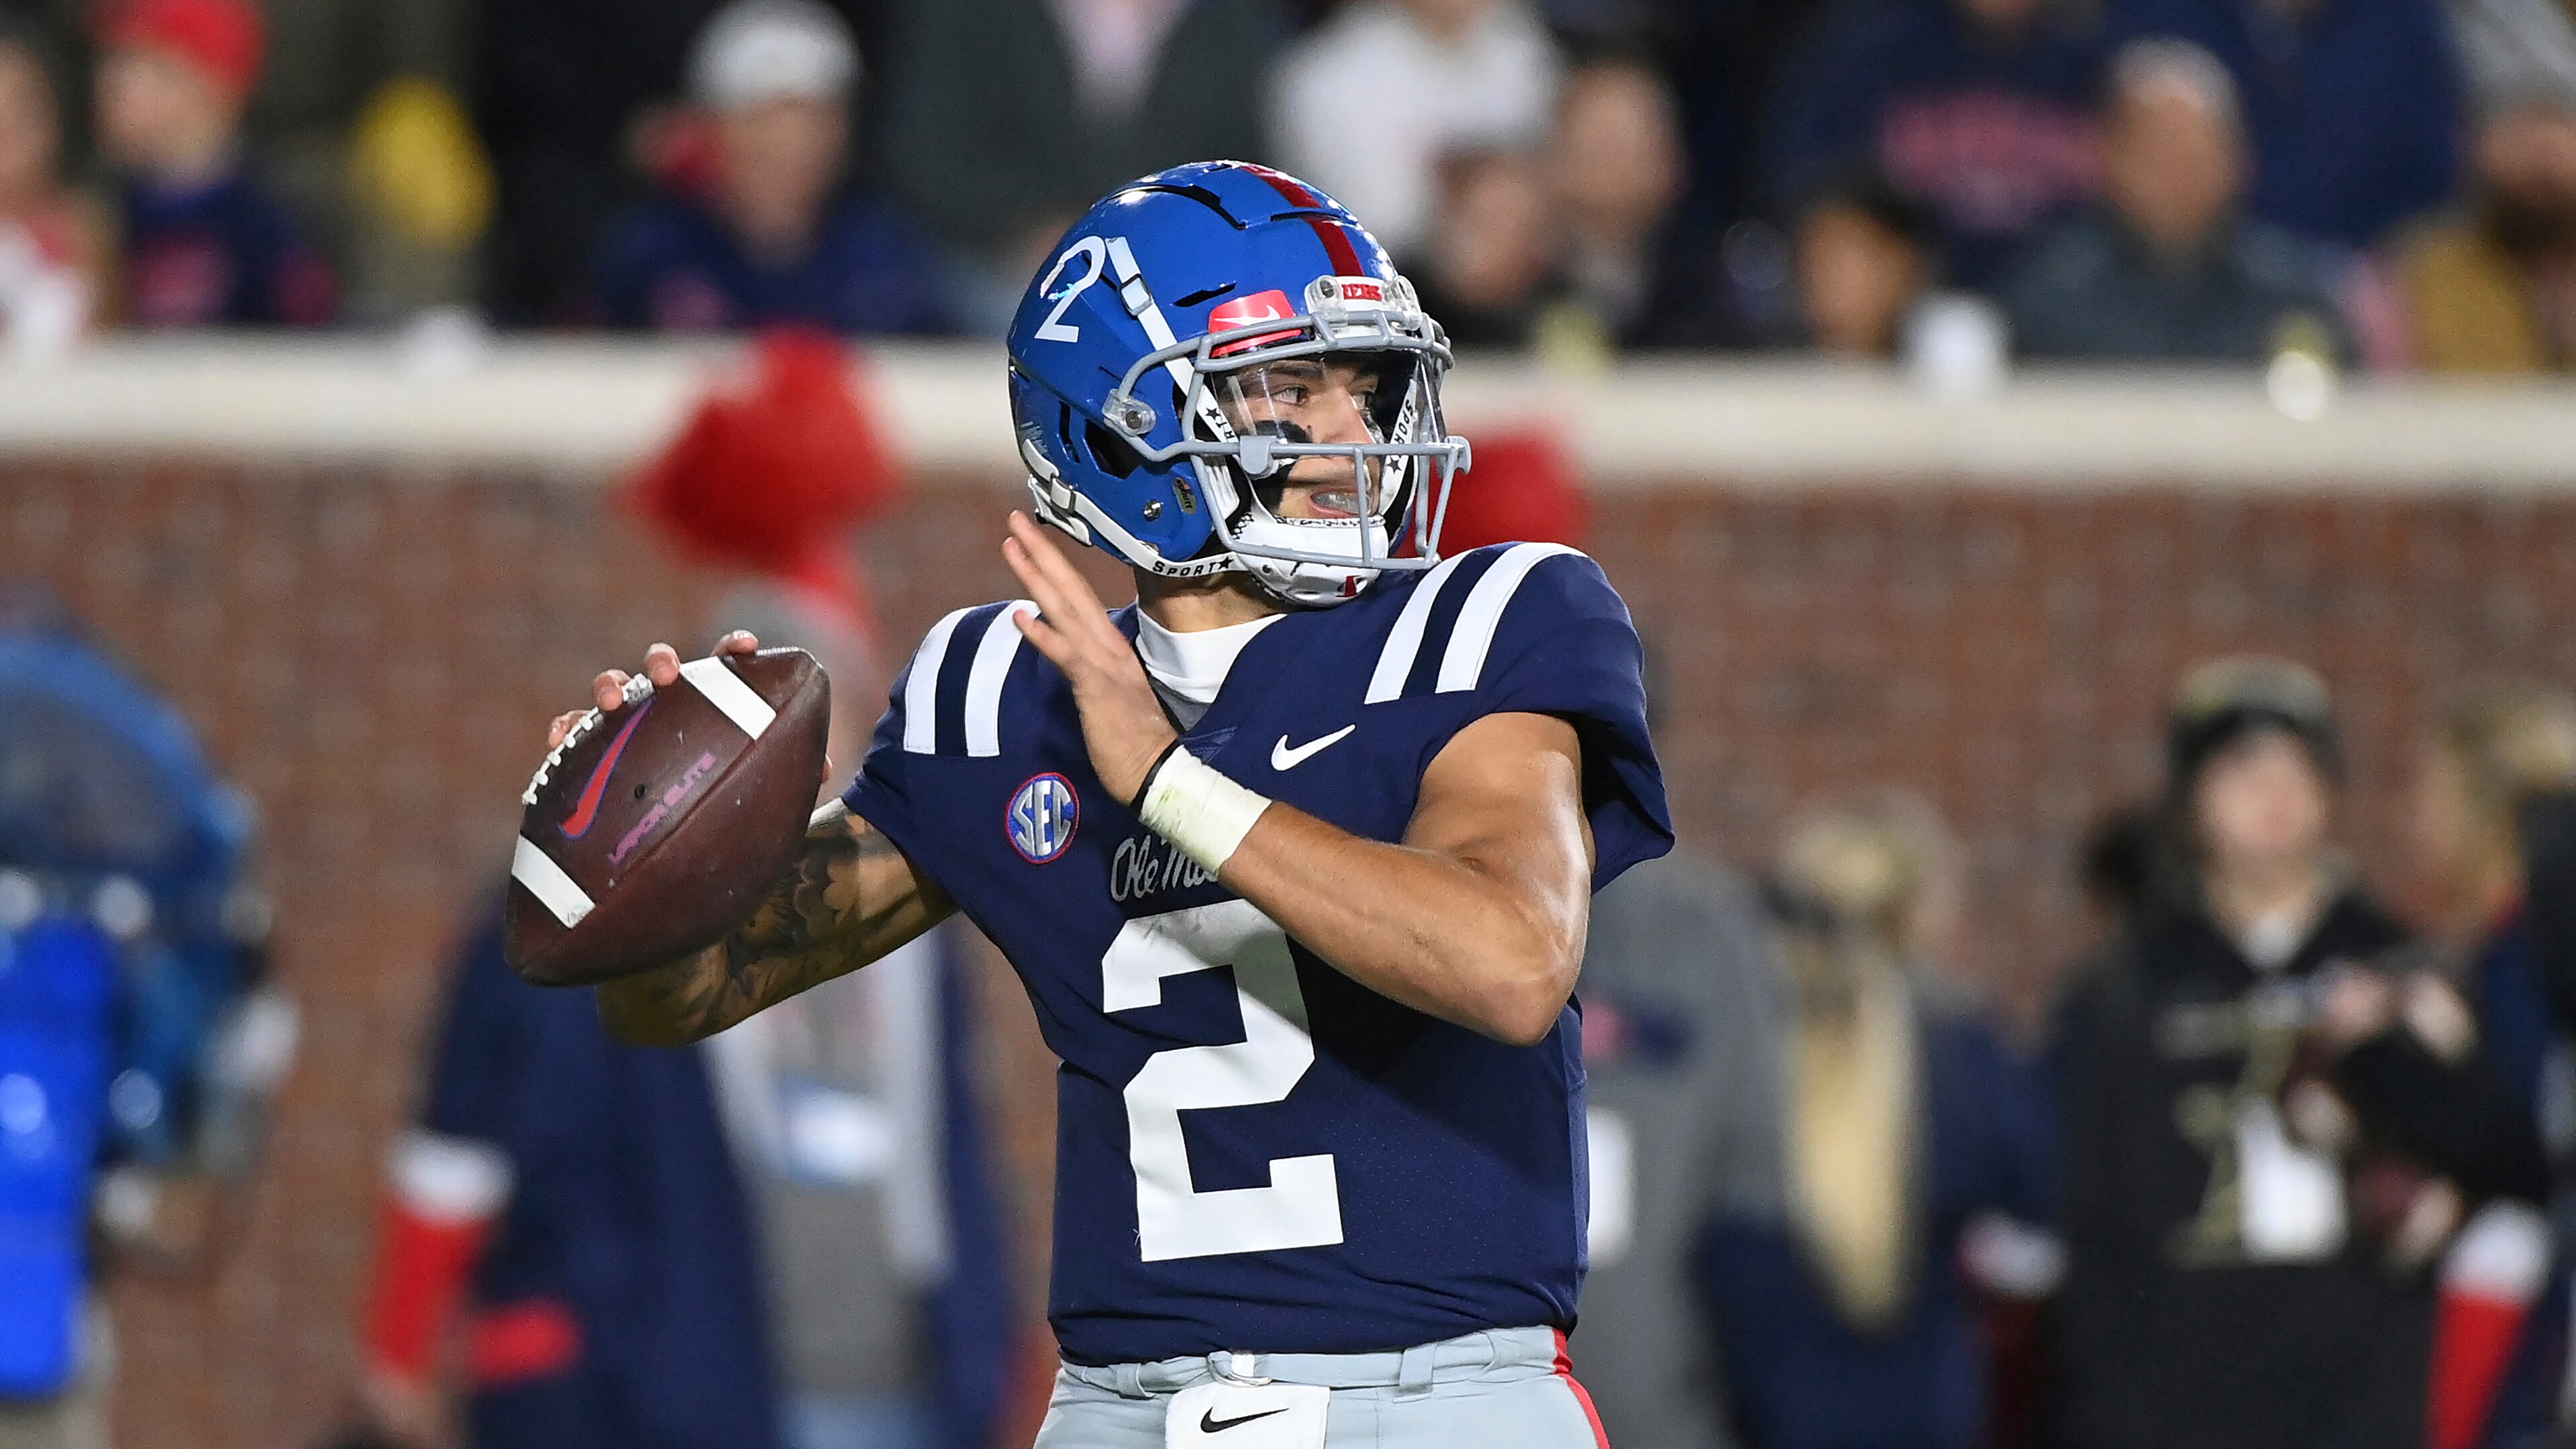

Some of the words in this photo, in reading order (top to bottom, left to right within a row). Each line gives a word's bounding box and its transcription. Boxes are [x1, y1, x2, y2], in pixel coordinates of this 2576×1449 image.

[1033, 235, 1106, 343] 2
[1394, 398, 1413, 458] SPOR
[1012, 780, 1072, 856] SEC
[1111, 835, 1159, 902] Ole
[1102, 899, 1343, 1261] 2
